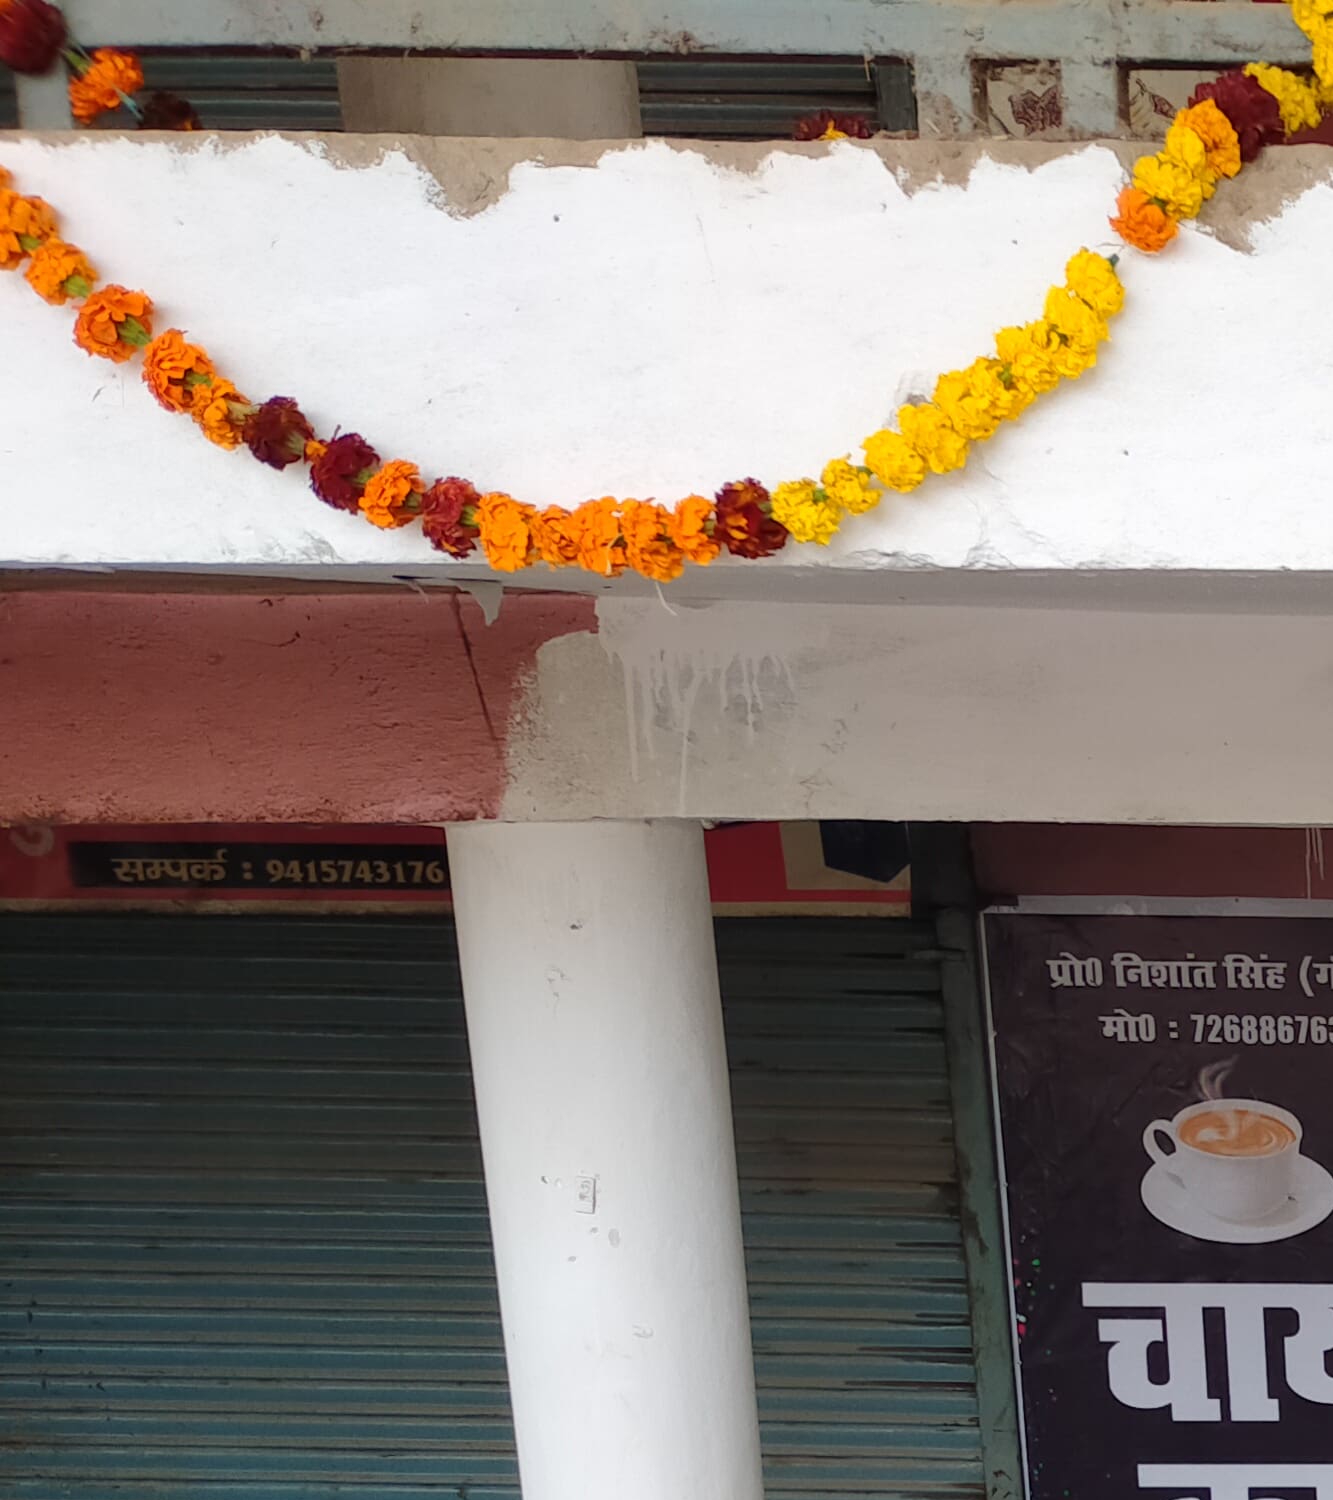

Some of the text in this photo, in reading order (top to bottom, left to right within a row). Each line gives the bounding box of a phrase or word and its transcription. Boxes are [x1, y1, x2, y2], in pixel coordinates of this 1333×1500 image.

[109, 847, 228, 883] सम्पर्क
[265, 858, 445, 884] 9415743176
[1113, 952, 1217, 989] निशांत
[1223, 953, 1287, 991] सिंह
